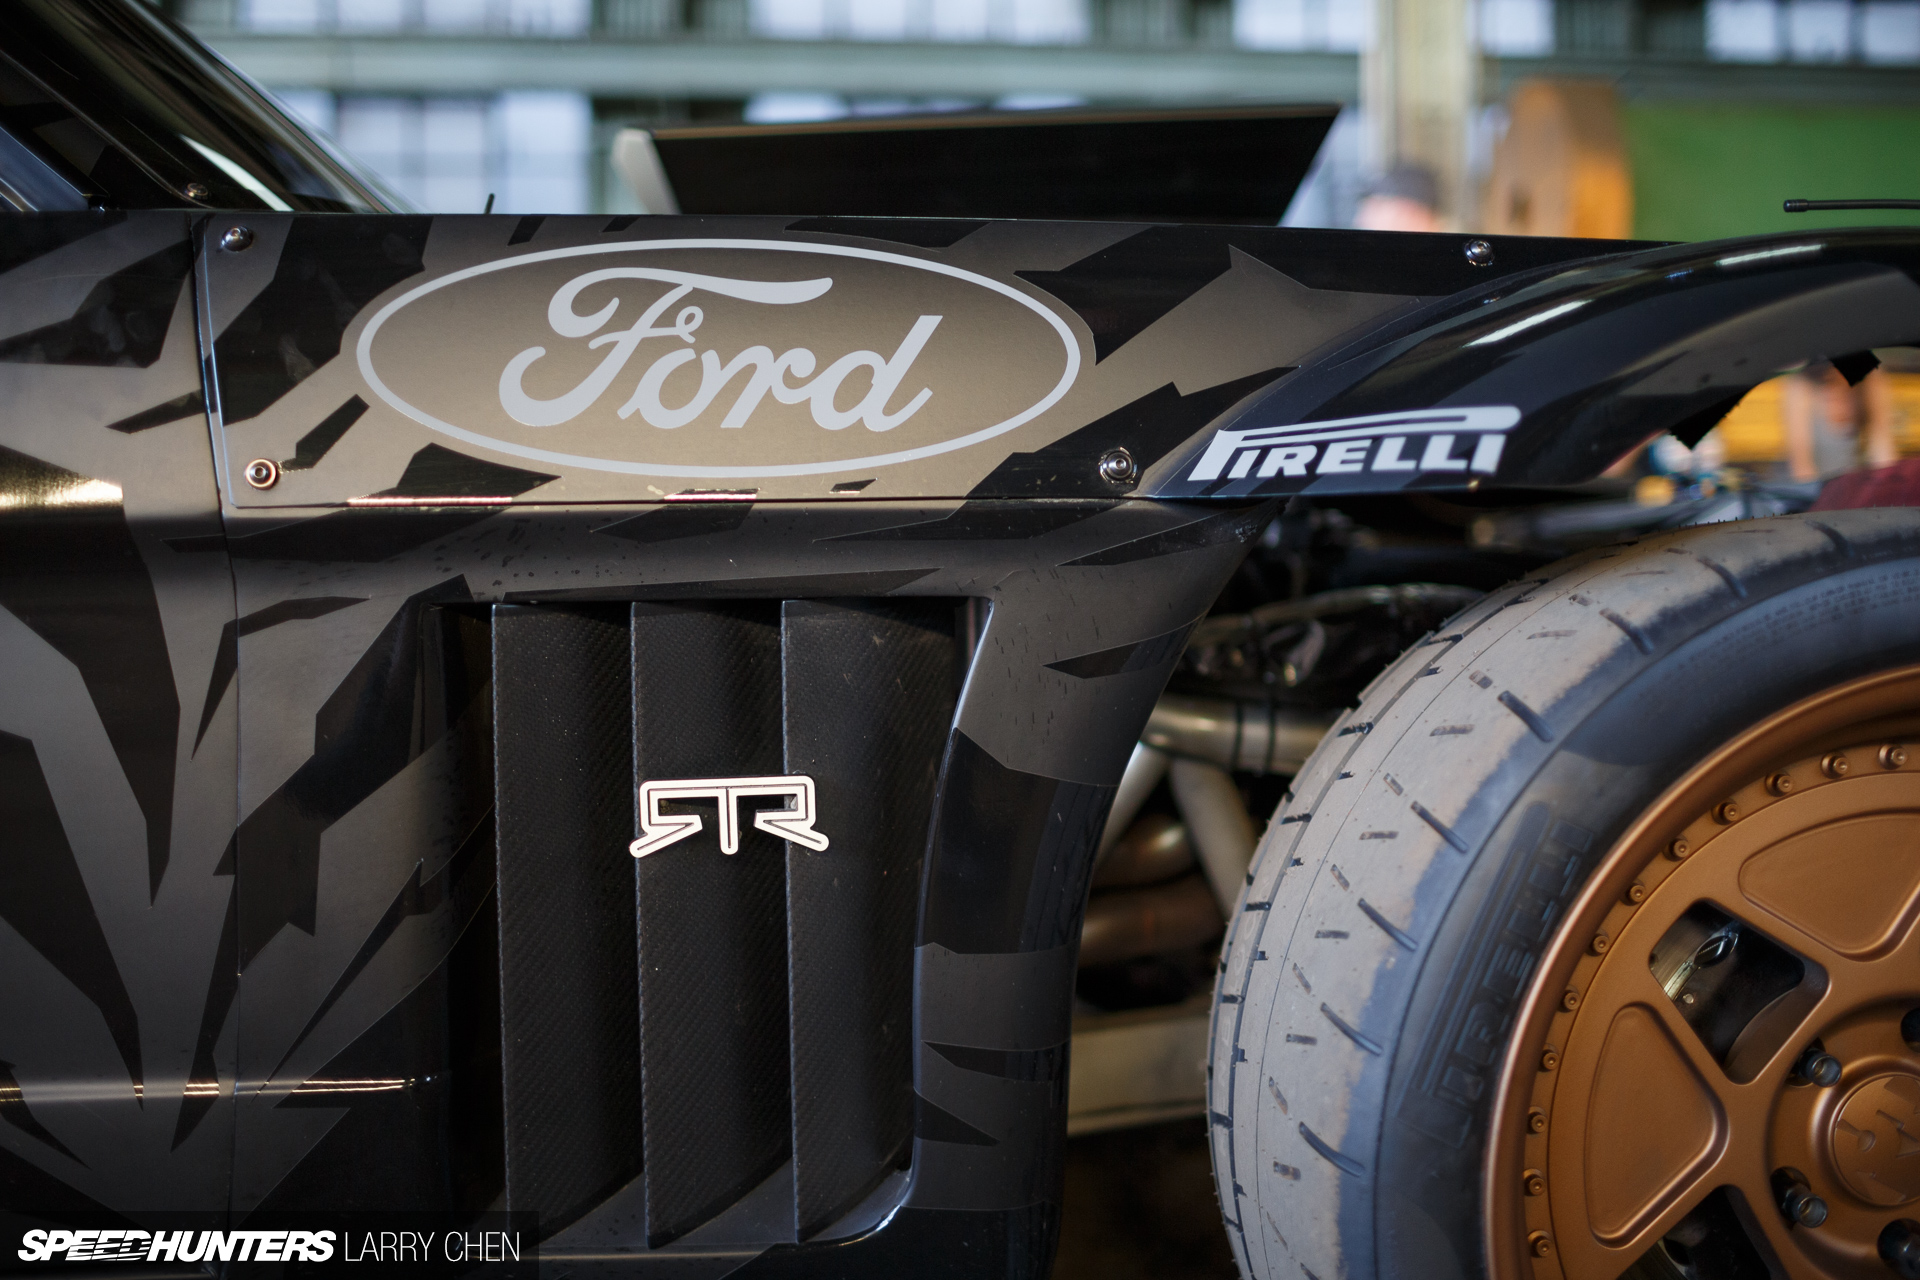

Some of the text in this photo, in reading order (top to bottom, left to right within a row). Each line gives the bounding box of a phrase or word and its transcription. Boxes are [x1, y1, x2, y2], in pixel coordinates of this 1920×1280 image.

[499, 267, 943, 432] Ford
[1187, 405, 1522, 482] PIRELLI
[1397, 800, 1593, 1149] PIRELLI
